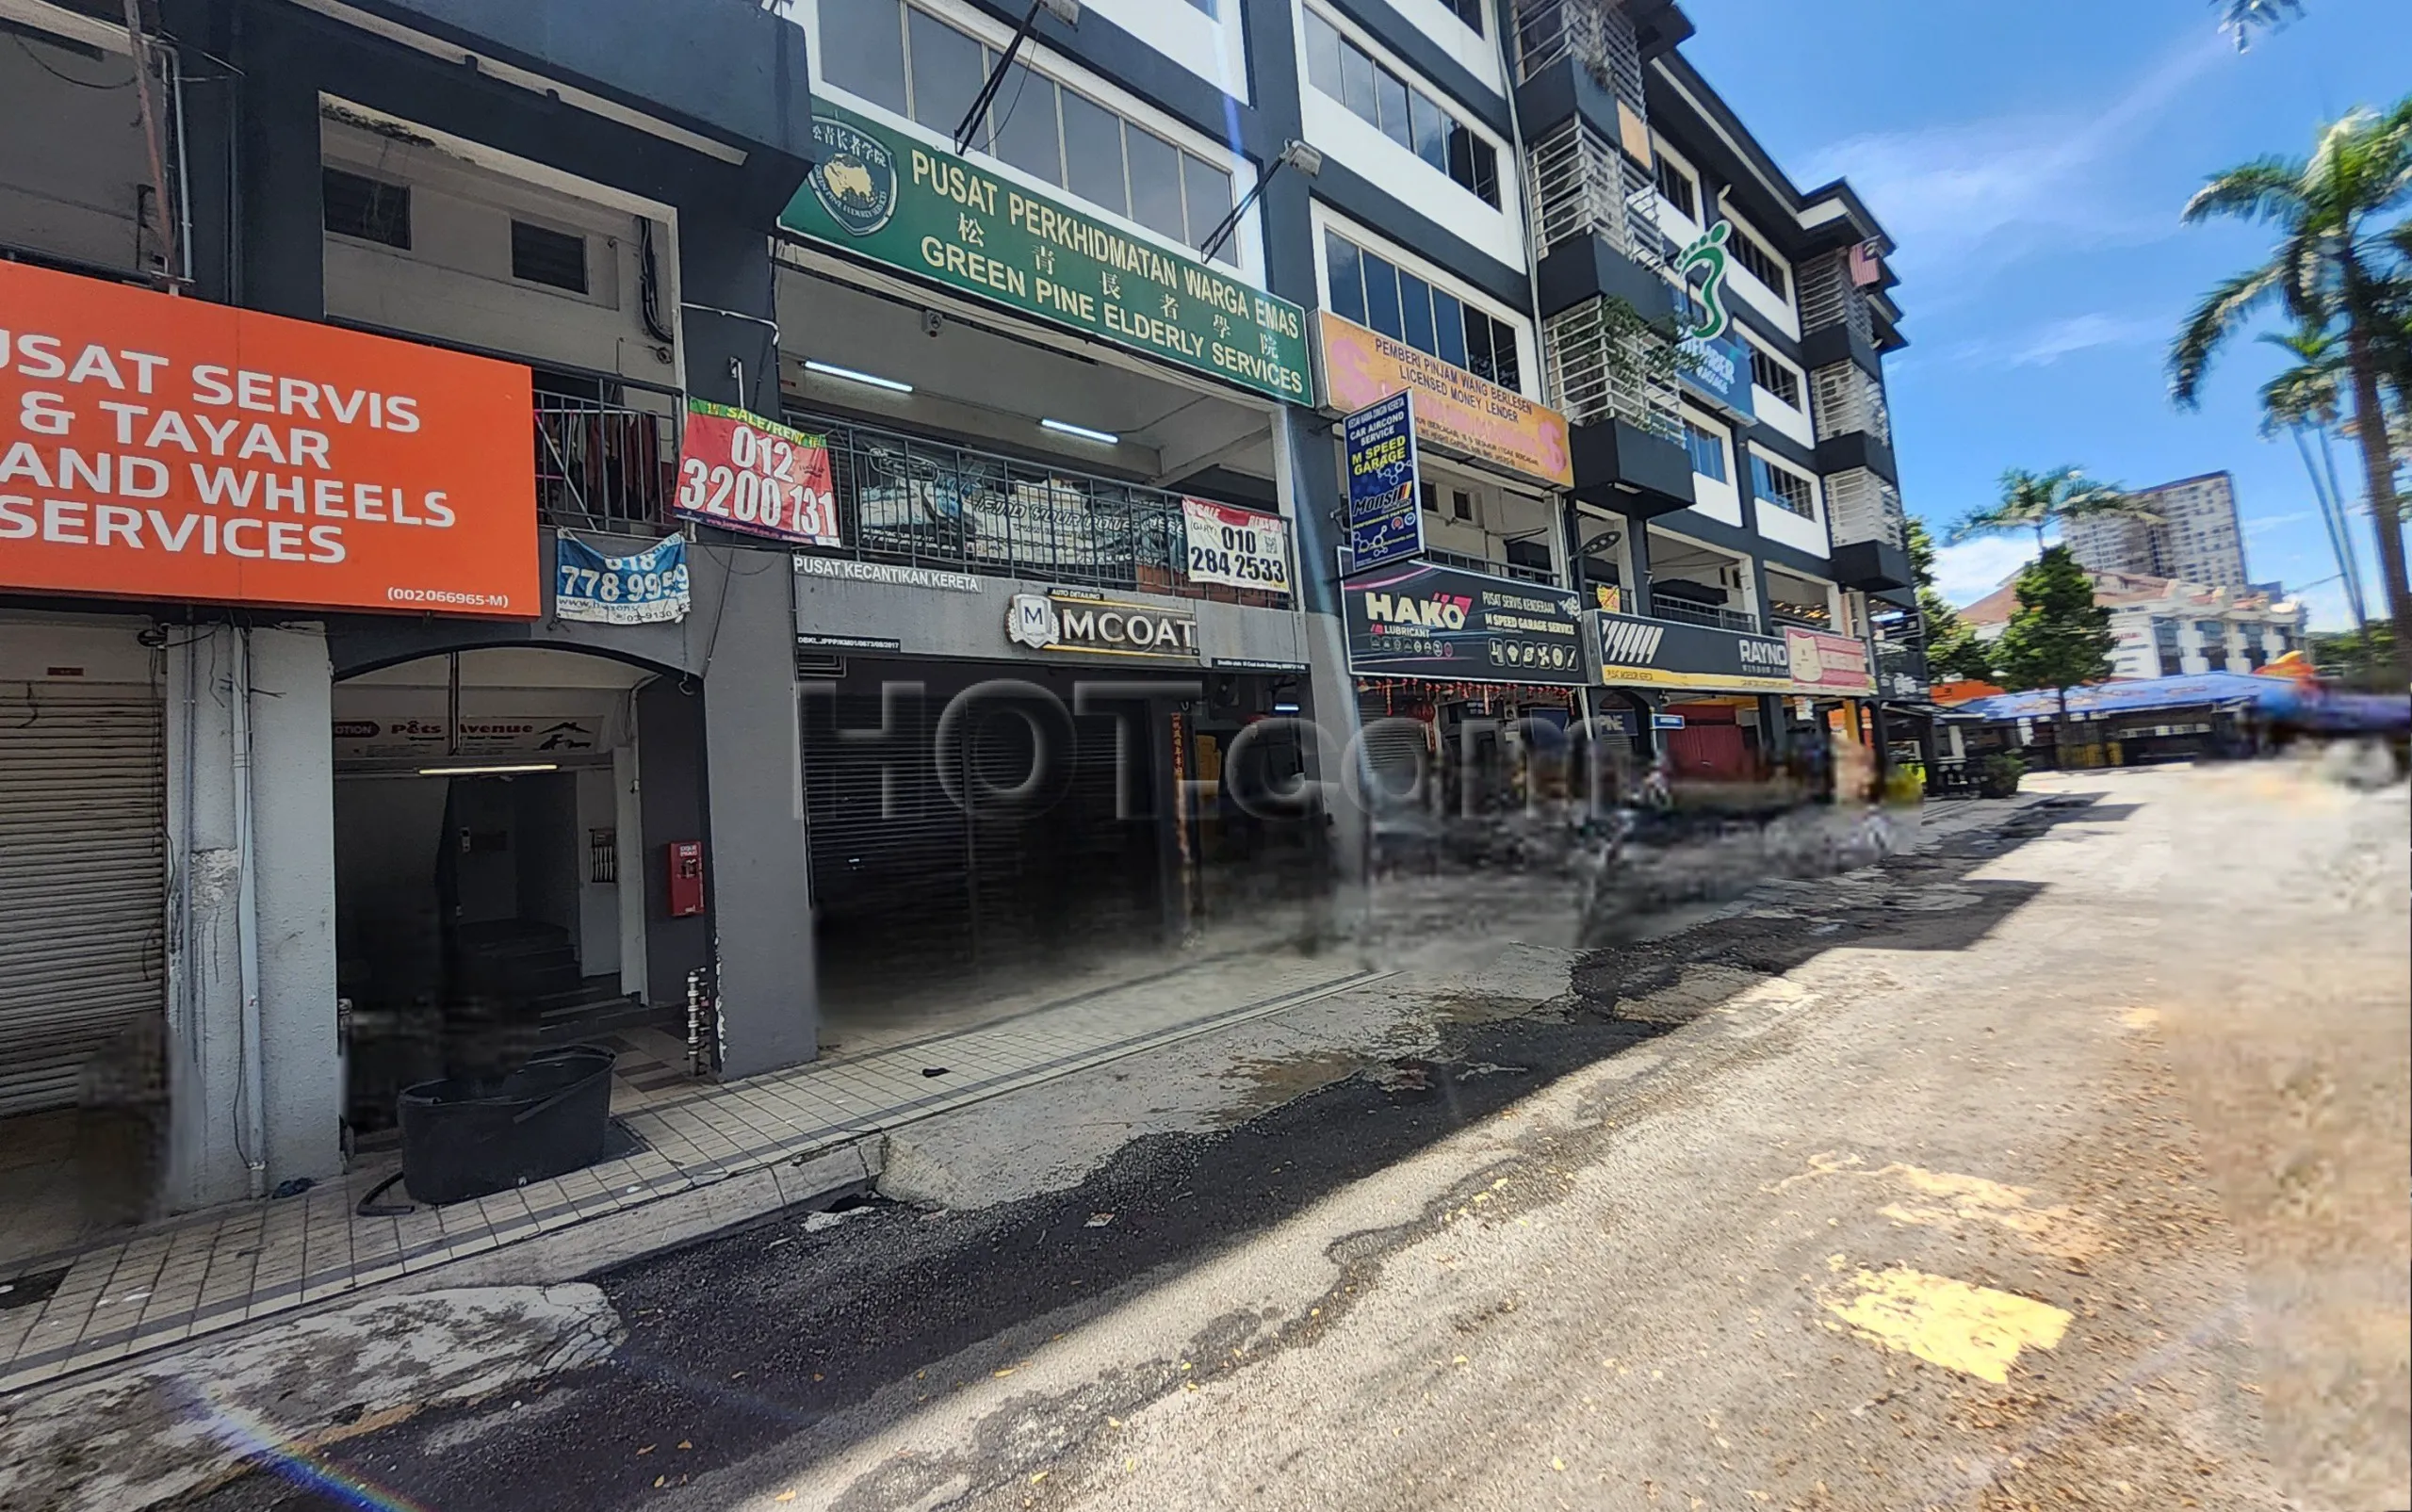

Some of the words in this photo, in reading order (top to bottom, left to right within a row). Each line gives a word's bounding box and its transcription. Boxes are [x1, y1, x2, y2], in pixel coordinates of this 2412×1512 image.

[911, 149, 998, 216] PUSAT
[1009, 191, 1177, 289] PERKHIDMATAN
[1183, 266, 1249, 320] WARGA
[1254, 297, 1299, 339] EMAS
[921, 236, 1025, 297] GREEN
[1036, 282, 1095, 323] PINE
[1103, 301, 1204, 358] ELDERLY
[1212, 342, 1303, 394] SERVICES
[0, 329, 170, 395] SAT
[192, 364, 420, 433] SERVIS
[1375, 338, 1421, 368] PEMBERI
[1424, 358, 1459, 383] PINJAM
[1460, 373, 1488, 397] WANG
[1491, 386, 1532, 415] BERLESEN
[1399, 366, 1447, 397] LICENSED
[1450, 386, 1482, 411] MONEY
[1486, 402, 1519, 423] LENDER
[20, 390, 75, 435] &
[99, 399, 331, 469] TAYAR
[1349, 427, 1366, 441] CAR
[1368, 411, 1404, 433] AIRCOND
[1361, 425, 1395, 447] SERVICE
[731, 425, 794, 483] 012
[1352, 452, 1362, 465] M
[1365, 435, 1406, 460] SPEED
[1354, 447, 1406, 476] GARAGE
[0, 442, 170, 499] AND
[189, 463, 456, 528] WHEELS
[679, 458, 782, 528] 3200
[789, 484, 838, 536] 131
[0, 495, 346, 563] SERVICES
[1221, 527, 1257, 555] 010
[793, 557, 841, 577] PUSAT
[844, 563, 928, 586] KECANTIKAN
[931, 573, 979, 591] KERETA
[1190, 546, 1231, 576] 284
[1234, 554, 1285, 583] 2533
[387, 586, 509, 610] (002066965-M)
[562, 565, 620, 602] 778
[1051, 588, 1068, 597] AUTO
[1069, 590, 1100, 600] DETAILING
[1023, 606, 1044, 626] M
[1062, 609, 1197, 647] MCOAT
[1365, 592, 1470, 630] HAKO
[1384, 625, 1430, 639] LUBRICANT
[1739, 640, 1787, 666] RAYNO
